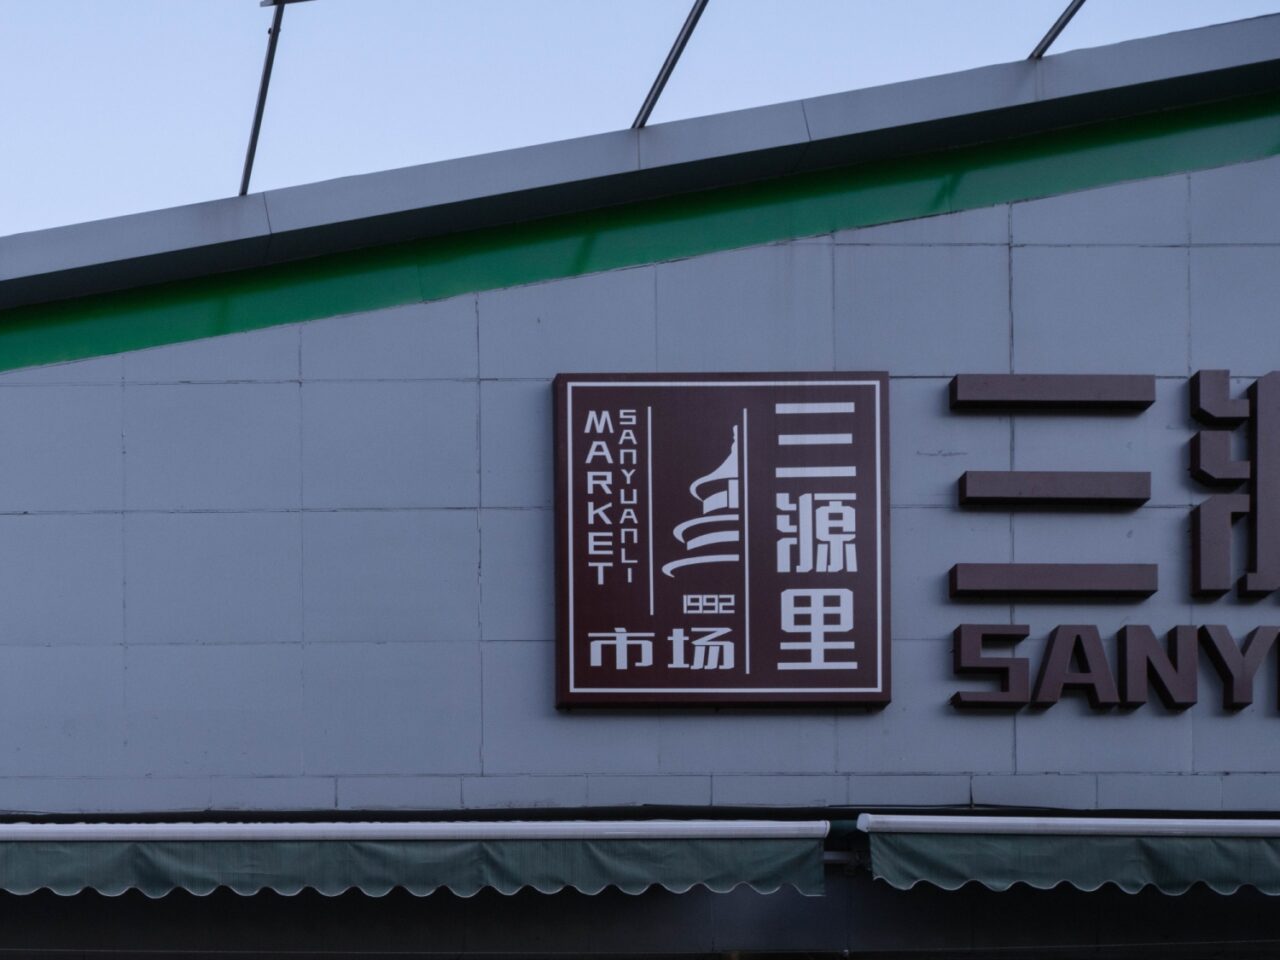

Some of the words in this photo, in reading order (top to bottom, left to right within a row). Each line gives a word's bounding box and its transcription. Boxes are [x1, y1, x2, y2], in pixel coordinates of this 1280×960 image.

[583, 410, 615, 585] MARKET
[775, 402, 858, 670] 三源里
[587, 626, 735, 670] 市场
[683, 594, 735, 614] 1992
